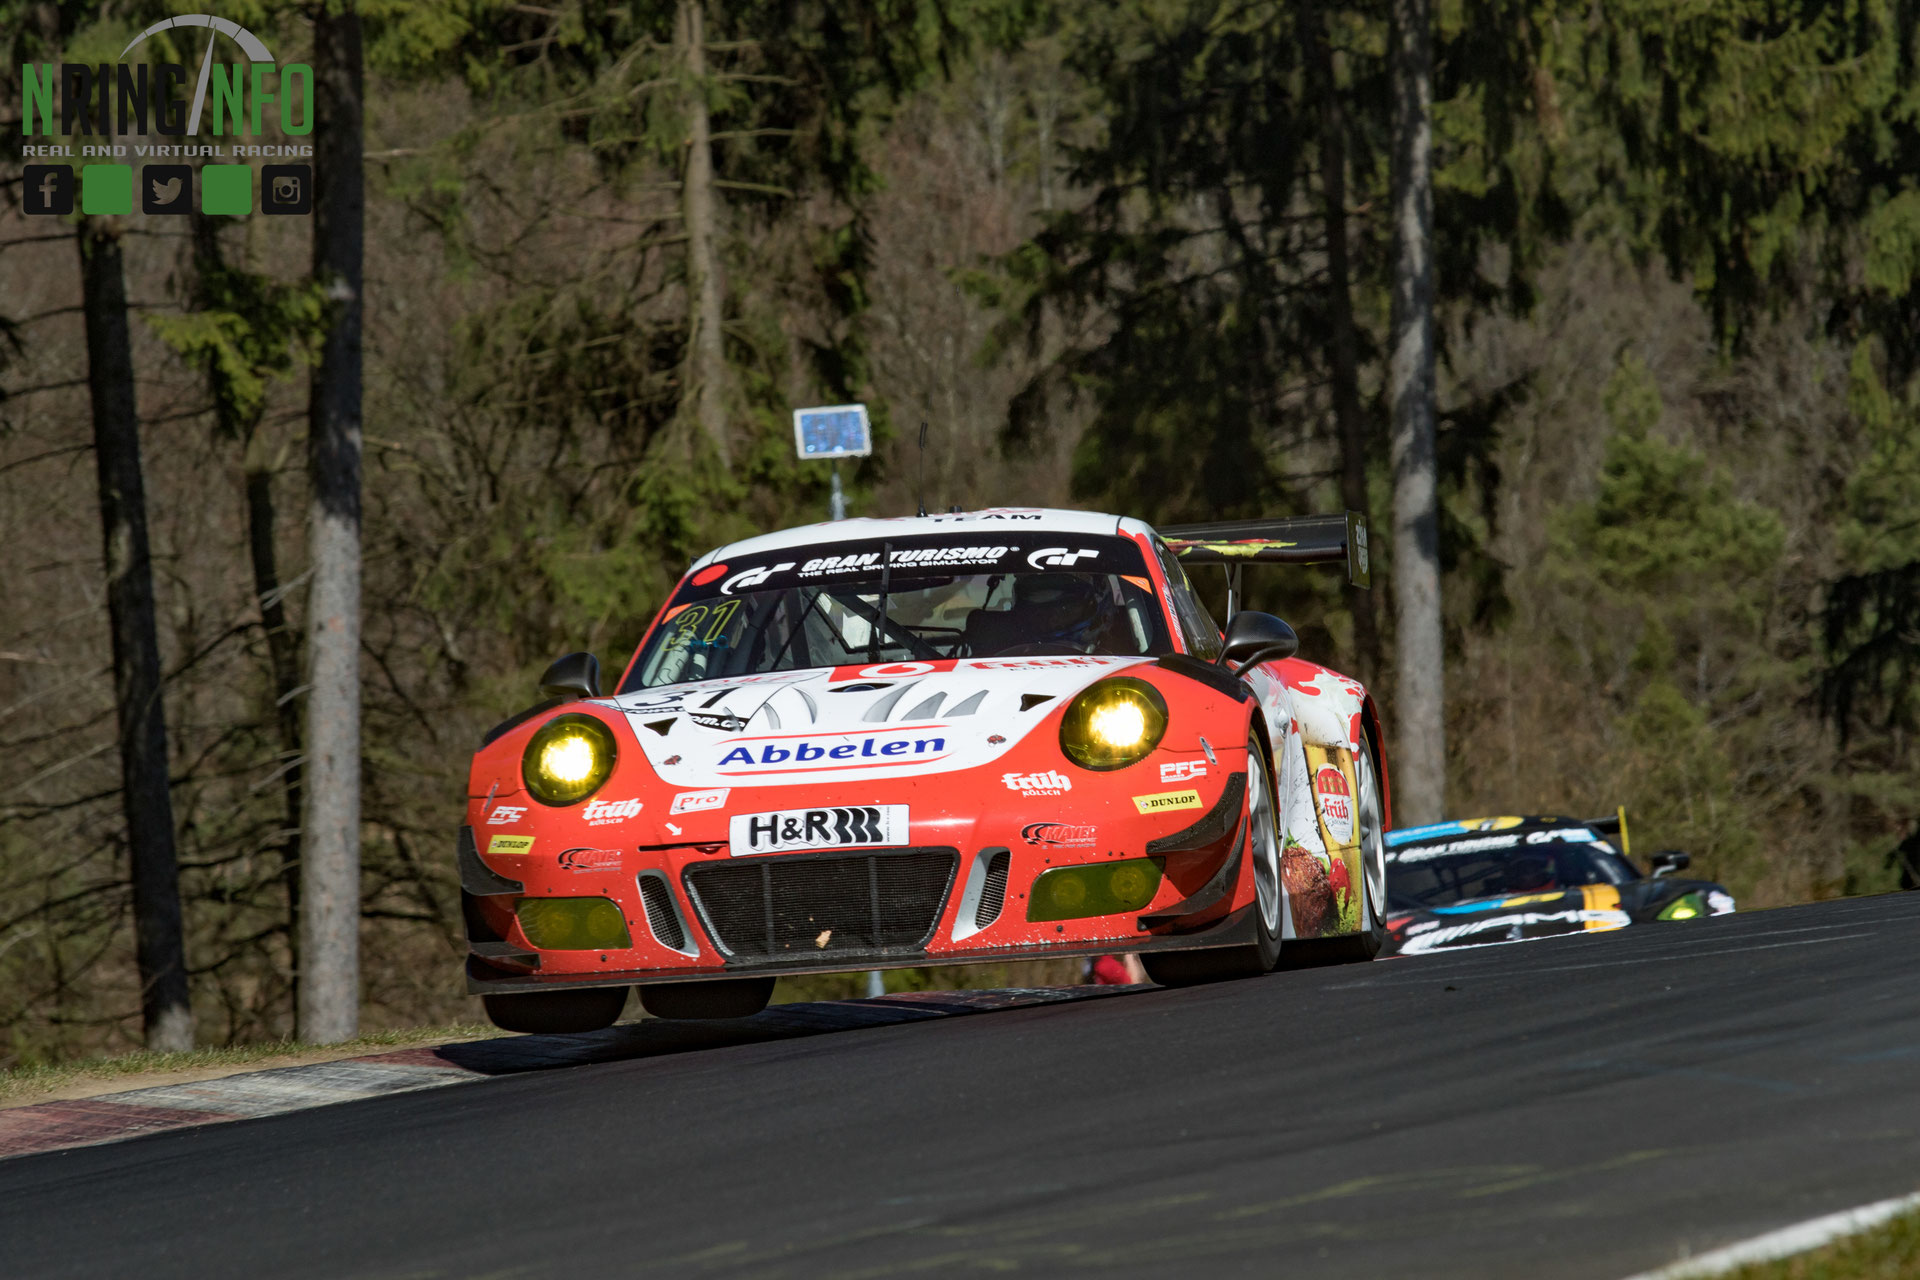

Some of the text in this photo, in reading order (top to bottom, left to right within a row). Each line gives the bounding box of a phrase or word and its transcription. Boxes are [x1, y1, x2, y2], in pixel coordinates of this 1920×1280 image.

[801, 546, 1008, 573] GRAN TURISMO
[826, 567, 859, 575] REAL
[919, 557, 998, 567] SIMULATOR
[661, 599, 742, 652] 31
[717, 737, 946, 766] Abbelen
[1160, 760, 1207, 776] PFC
[1022, 789, 1061, 797] KÖLSCH
[1150, 795, 1196, 808] DUNLOP
[680, 795, 719, 809] Pro
[750, 810, 833, 847] H&R
[1044, 825, 1098, 840] MAYER
